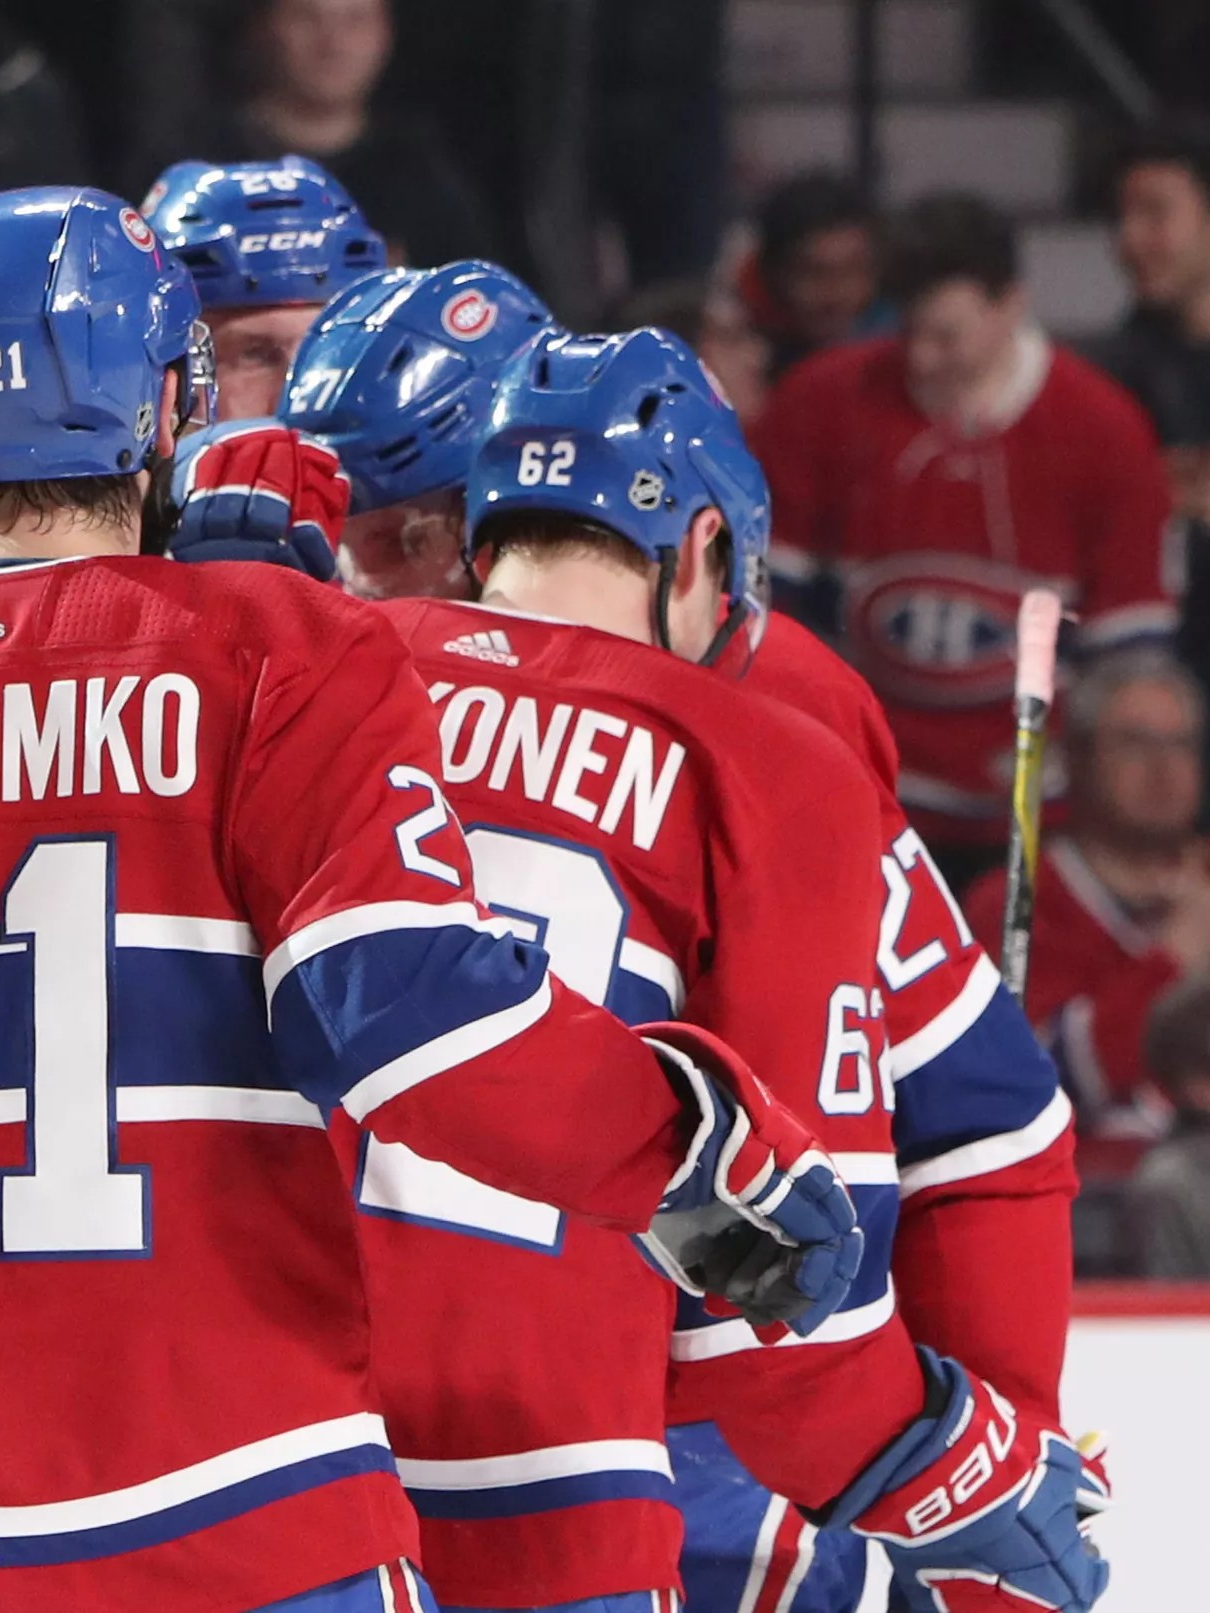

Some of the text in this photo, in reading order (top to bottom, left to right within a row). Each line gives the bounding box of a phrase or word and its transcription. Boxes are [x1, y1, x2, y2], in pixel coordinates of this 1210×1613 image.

[240, 230, 326, 254] CCM
[290, 368, 342, 414] 27
[517, 440, 576, 487] 62
[443, 639, 520, 667] adidas
[427, 681, 687, 852] ONEN
[387, 764, 464, 888] 2
[875, 825, 976, 993] 27
